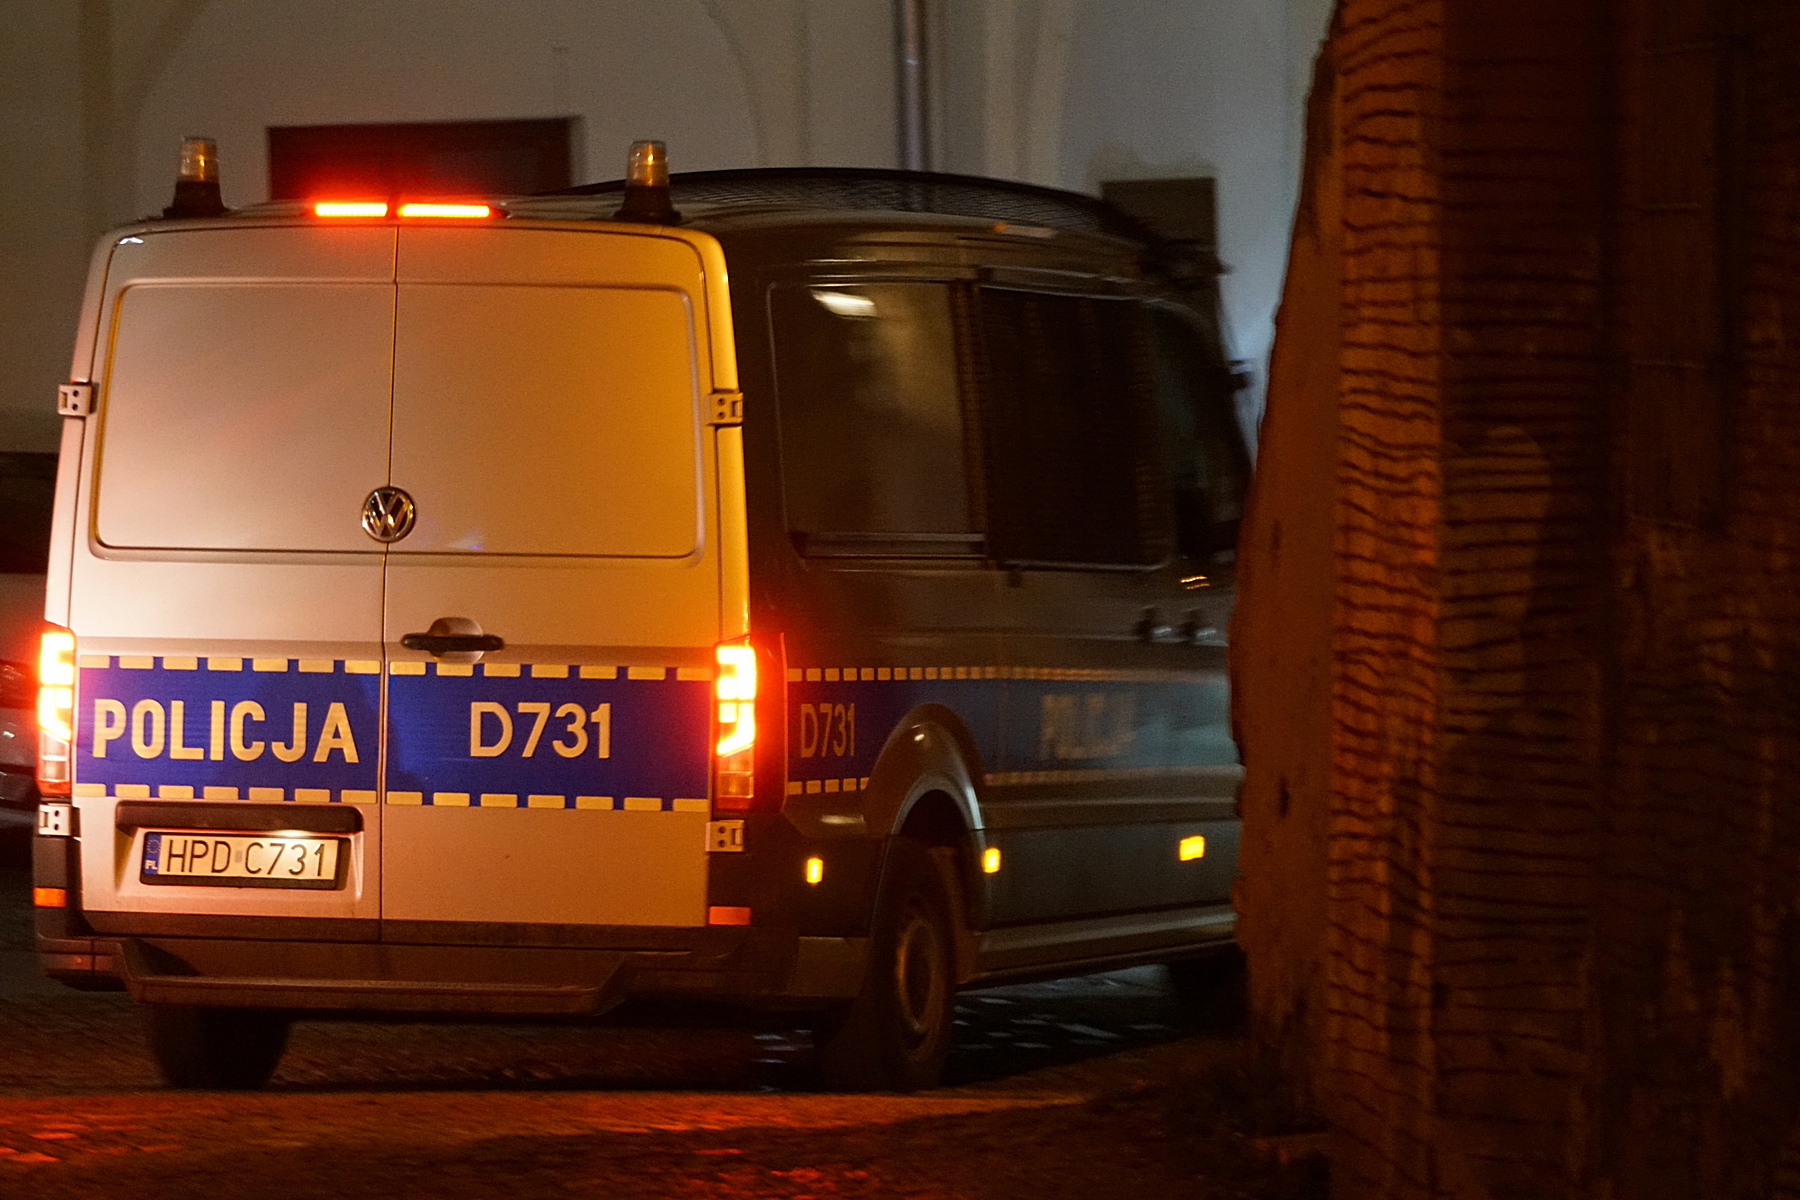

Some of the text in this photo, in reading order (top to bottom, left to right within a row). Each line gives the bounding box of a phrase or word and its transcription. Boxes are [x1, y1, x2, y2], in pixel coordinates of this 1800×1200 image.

[92, 698, 359, 763] POLICJA
[469, 701, 611, 759] D731
[800, 702, 856, 759] D731
[145, 860, 158, 870] PL
[166, 839, 325, 877] HPD C731
